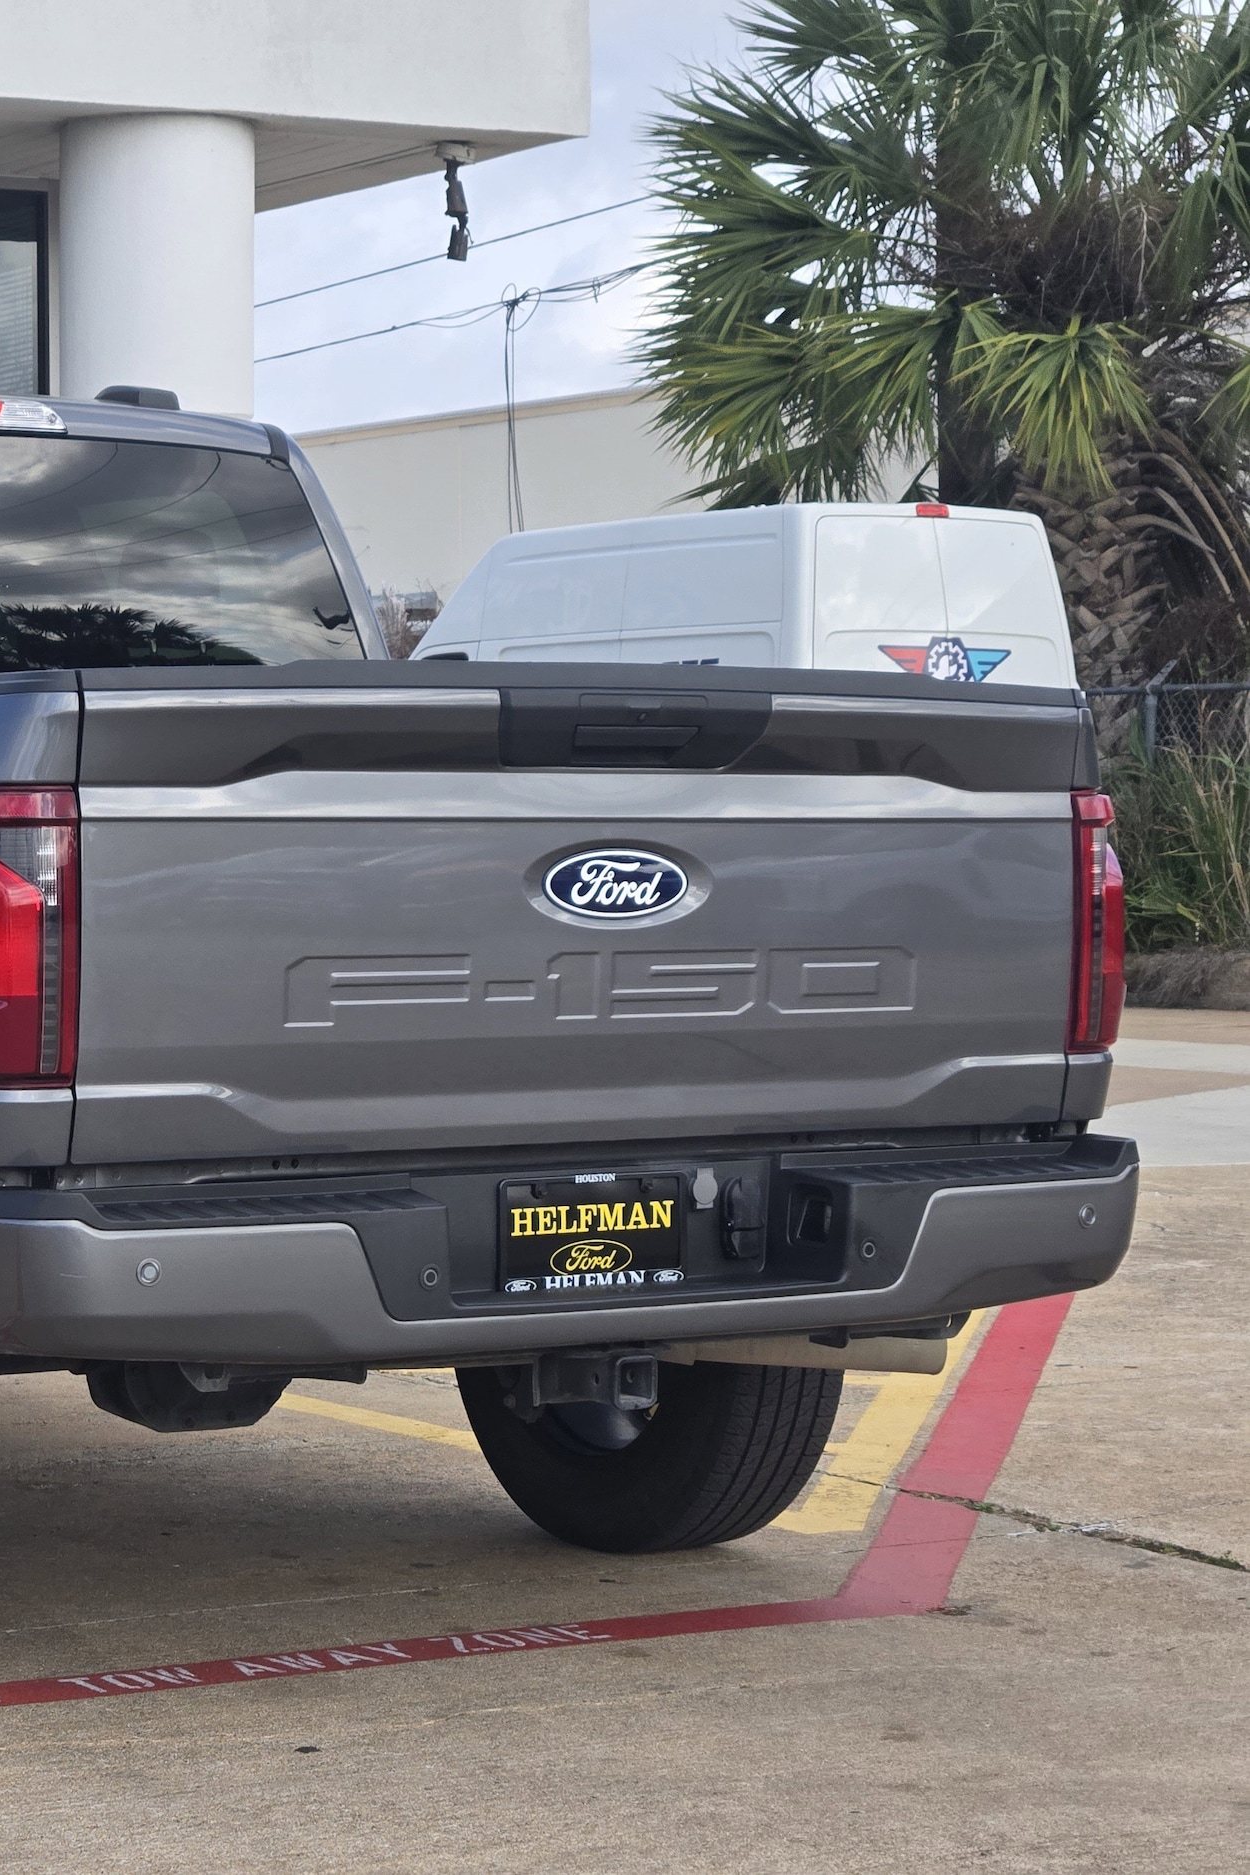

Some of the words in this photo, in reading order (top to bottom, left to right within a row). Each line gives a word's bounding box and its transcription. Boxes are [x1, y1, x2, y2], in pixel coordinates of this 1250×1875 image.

[571, 858, 661, 906] Ford
[284, 945, 917, 1028] F-150
[574, 1173, 617, 1184] HOUSTON
[510, 1200, 675, 1237] HELFMAN
[565, 1243, 617, 1272] Ford
[56, 1665, 203, 1694] TOW
[232, 1640, 413, 1679] AWAY
[428, 1622, 612, 1655] ZONE
